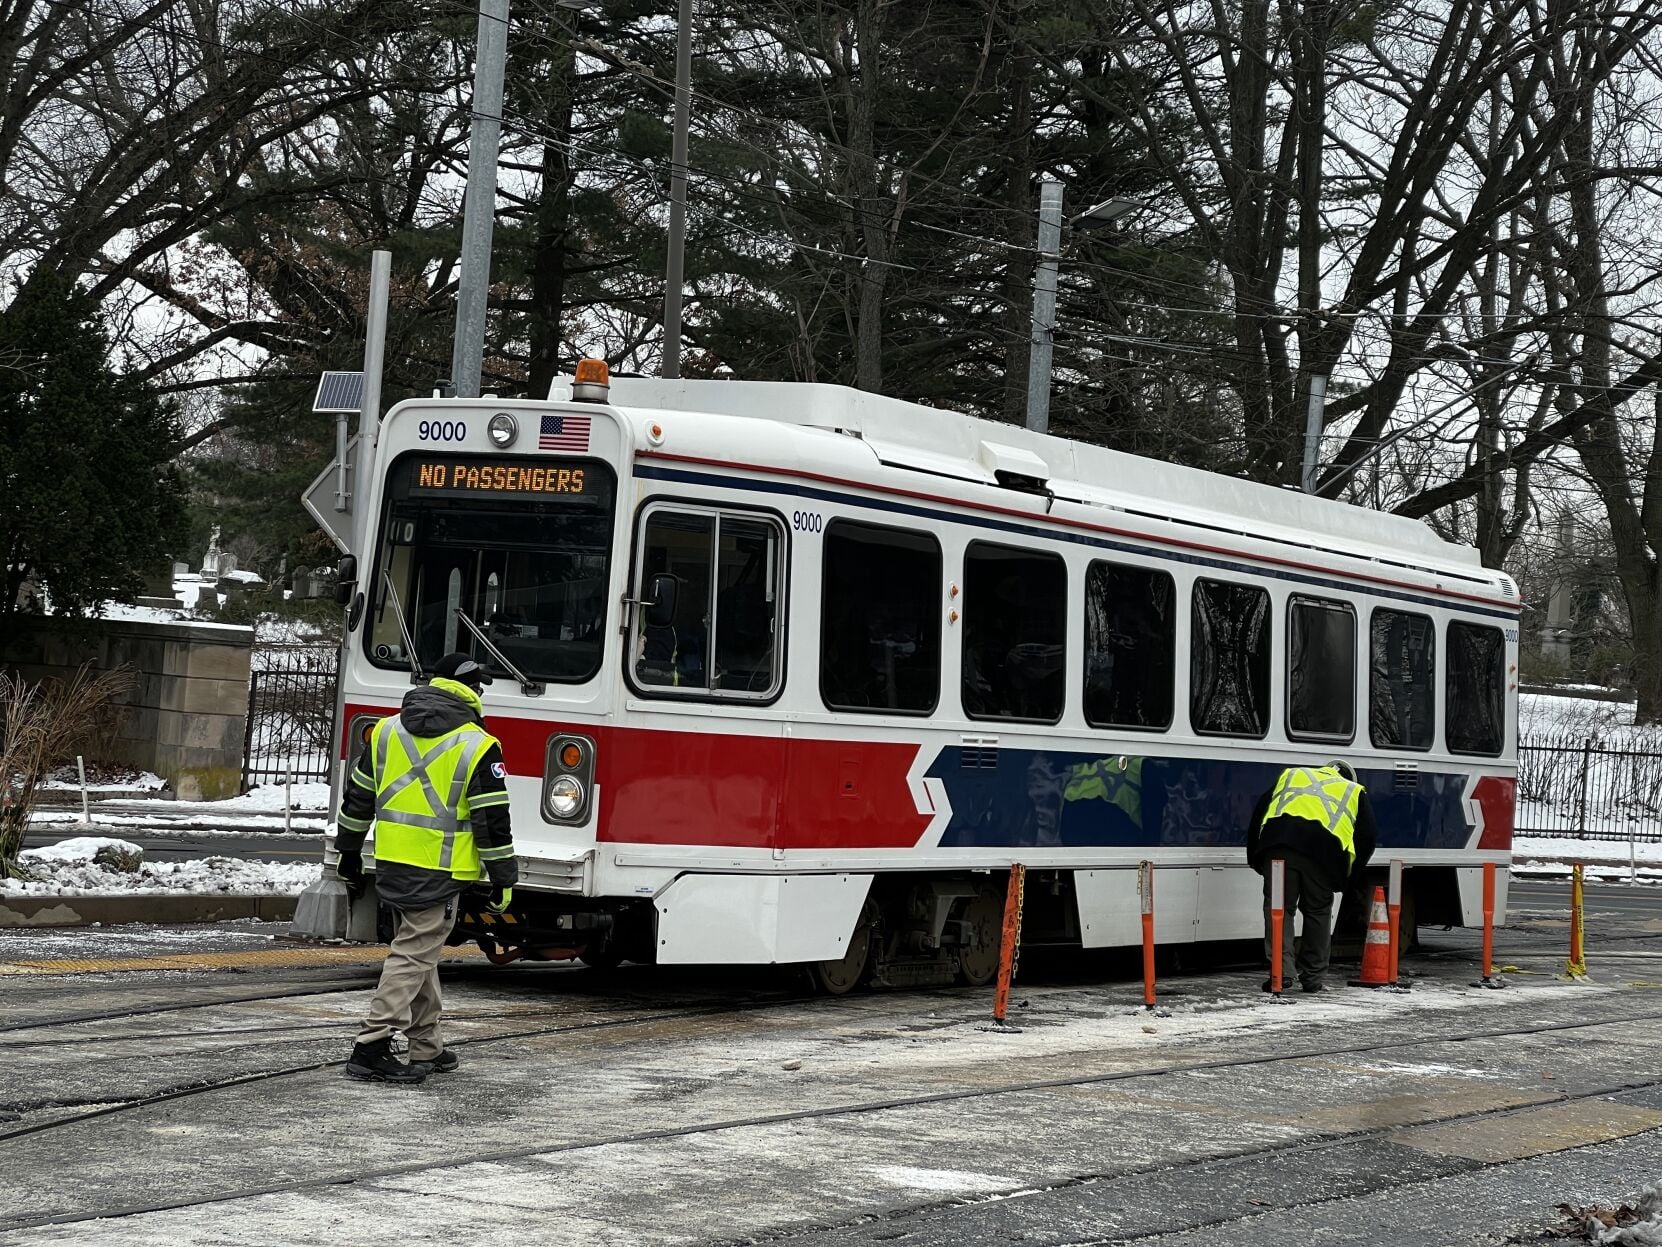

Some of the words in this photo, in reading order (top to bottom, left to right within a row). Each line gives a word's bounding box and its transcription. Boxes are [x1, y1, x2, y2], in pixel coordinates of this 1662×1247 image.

[418, 420, 467, 442] 9000
[419, 464, 446, 487] NO
[453, 465, 584, 493] PASSENGERS
[793, 510, 822, 533] 9000
[1505, 628, 1519, 643] 9000
